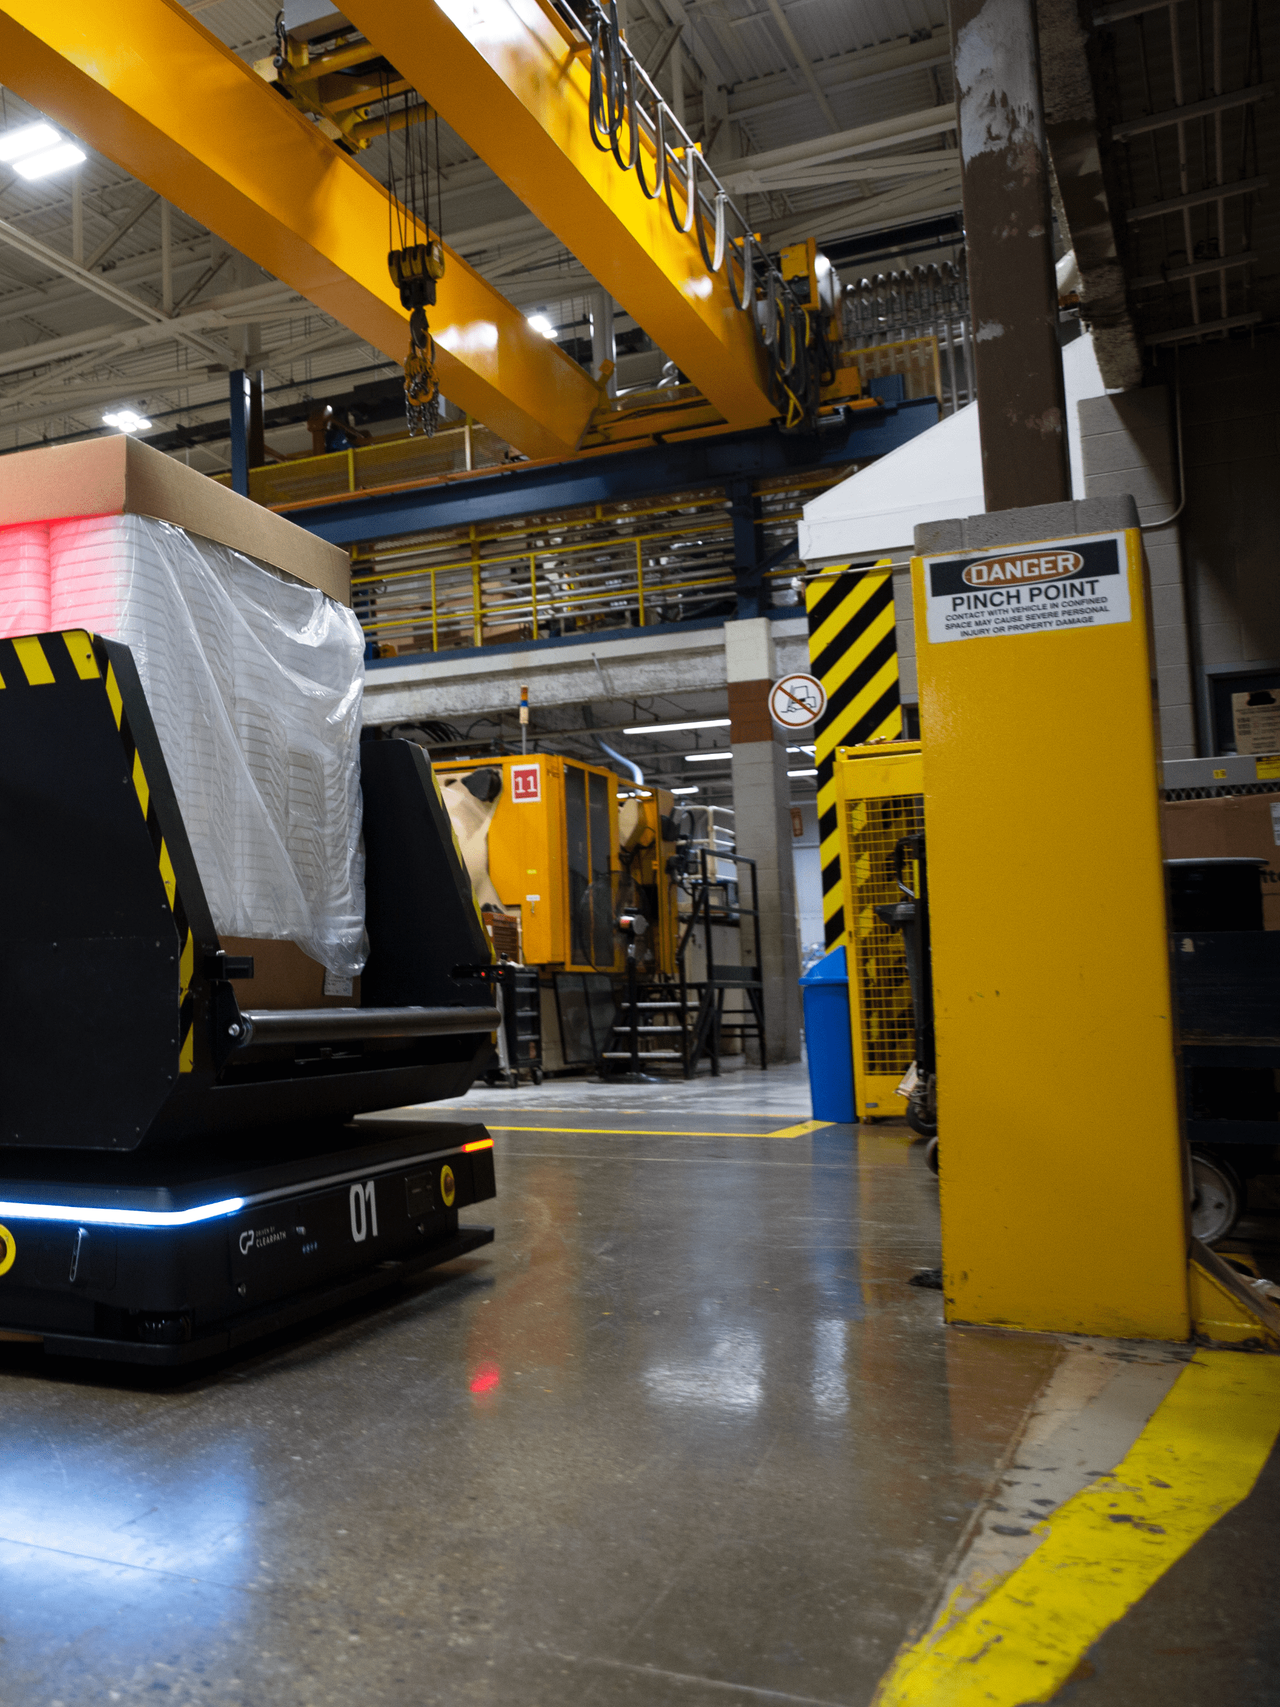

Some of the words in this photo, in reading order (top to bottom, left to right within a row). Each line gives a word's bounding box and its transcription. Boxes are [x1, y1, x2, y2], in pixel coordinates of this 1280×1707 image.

[971, 553, 1075, 584] DANGER
[952, 589, 1021, 612] PINCH
[1029, 579, 1099, 602] POINT
[945, 611, 985, 621] CONTACT
[987, 608, 1009, 616] WITH
[1010, 604, 1048, 613] VEHICLE
[1061, 596, 1108, 608] CONFINED
[945, 621, 972, 630] SPACE
[974, 619, 992, 627] MAY
[994, 615, 1023, 624] CAUSE
[1025, 611, 1059, 621] SEVERE
[1061, 605, 1110, 616] PERSONAL
[960, 628, 990, 637] INJURY
[1007, 621, 1053, 632] PROPERTY
[1056, 616, 1094, 626] DAMAGE
[515, 775, 537, 793] 11
[349, 1180, 378, 1243] 01
[255, 1230, 287, 1248] CLEARPATH
